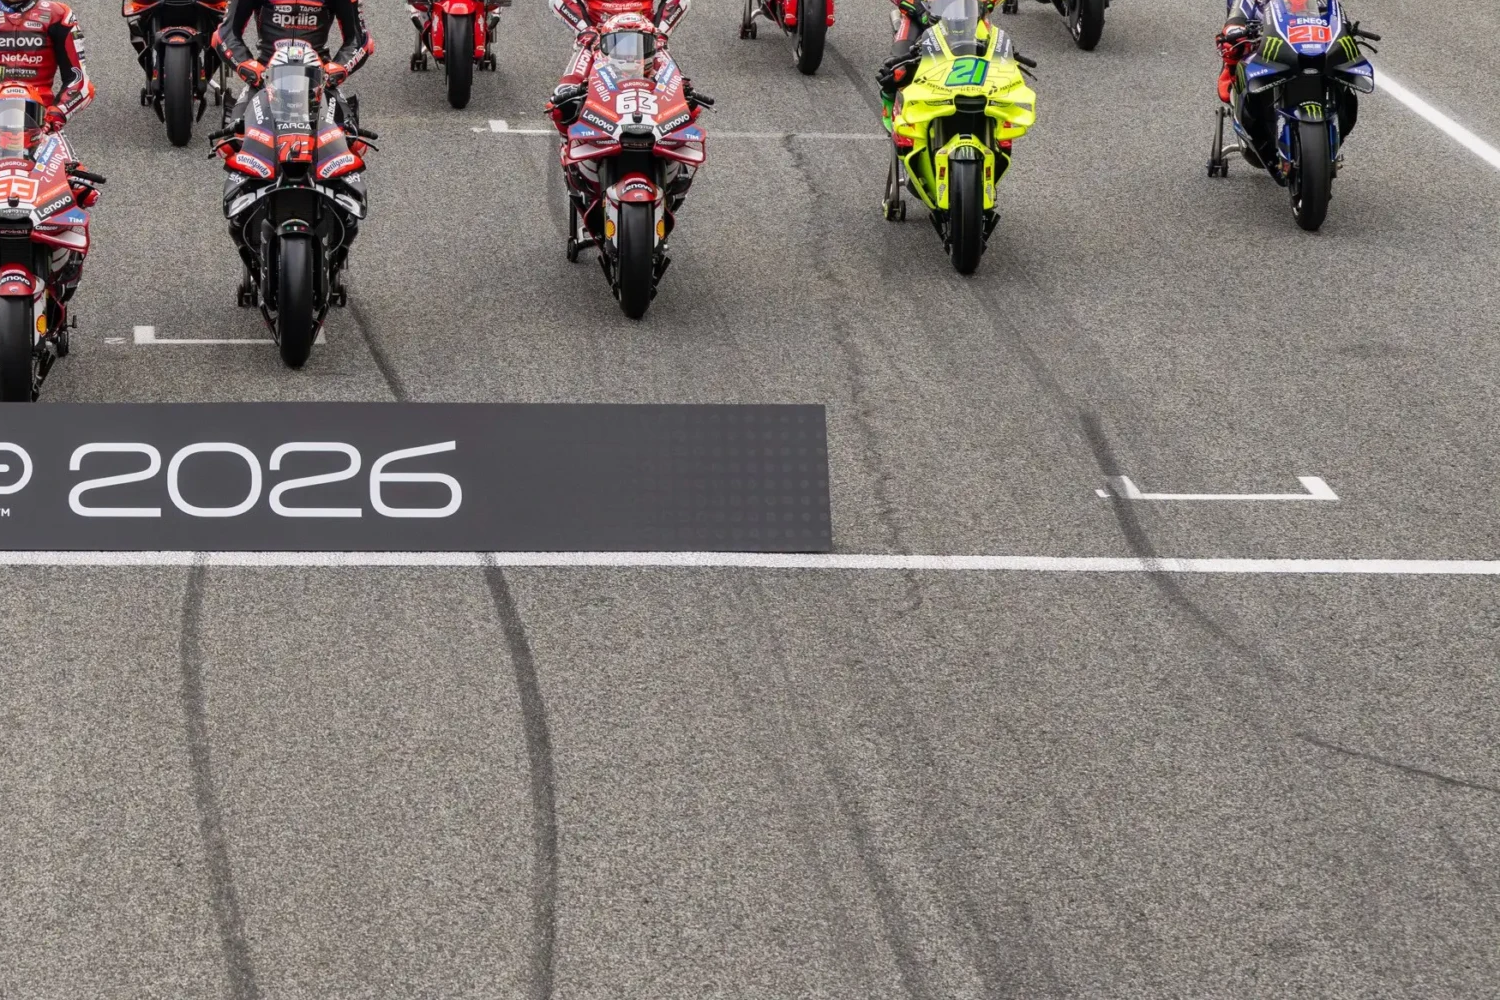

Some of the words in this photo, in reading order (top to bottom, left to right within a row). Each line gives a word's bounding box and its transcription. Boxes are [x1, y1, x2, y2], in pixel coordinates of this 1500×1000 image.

[299, 5, 322, 13] TARGA
[561, 7, 578, 23] Lenovo
[666, 7, 682, 25] Lenovo
[272, 12, 318, 27] aprilia
[1296, 16, 1328, 26] ENEOS
[1287, 25, 1333, 44] 20
[1, 53, 43, 64] NetApp
[5, 68, 37, 76] MONSTER
[944, 57, 990, 87] 21
[592, 77, 611, 102] riello
[667, 75, 682, 98] riello
[926, 82, 953, 92] PERTAMINA
[999, 80, 1023, 92] PERTAMINA
[66, 93, 83, 108] Lenovo
[616, 89, 659, 115] 63
[582, 110, 615, 132] Lenovo
[659, 113, 691, 137] Lenovo
[46, 153, 66, 183] riello
[237, 155, 271, 177] sterilgarda
[321, 155, 354, 178] sterilgarda
[228, 174, 245, 184] sky
[347, 173, 361, 184] sky
[621, 182, 654, 193] Lenovo
[39, 194, 72, 218] Lenovo
[68, 216, 83, 224] TIM
[68, 439, 463, 518] 2026
